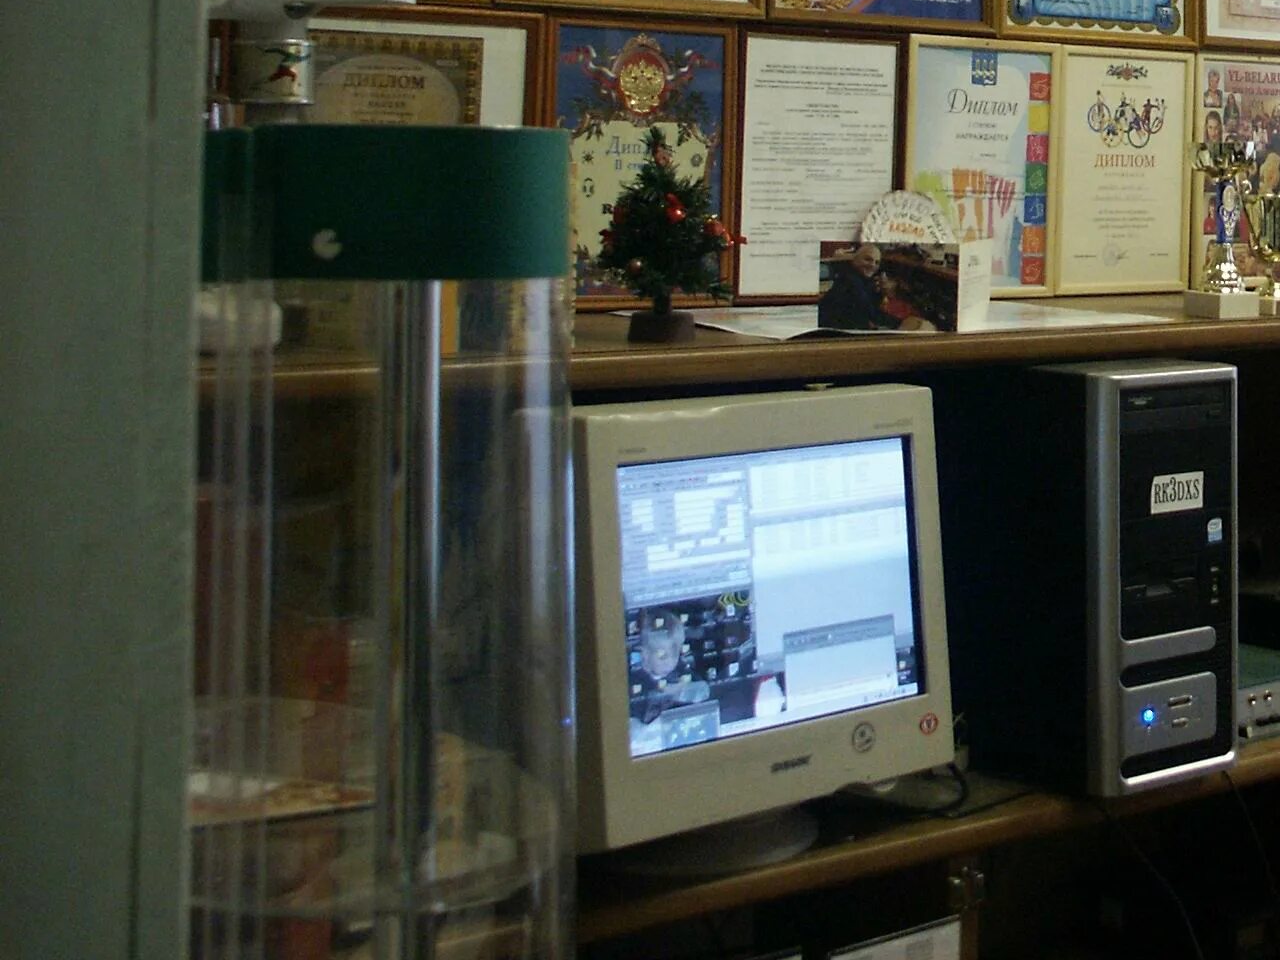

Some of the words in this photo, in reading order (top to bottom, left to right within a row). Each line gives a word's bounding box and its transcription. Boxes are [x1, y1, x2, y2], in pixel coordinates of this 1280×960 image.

[948, 88, 1019, 117] Диплом
[1094, 154, 1156, 169] ДИПЛОМ
[1154, 477, 1200, 505] RK3DXS
